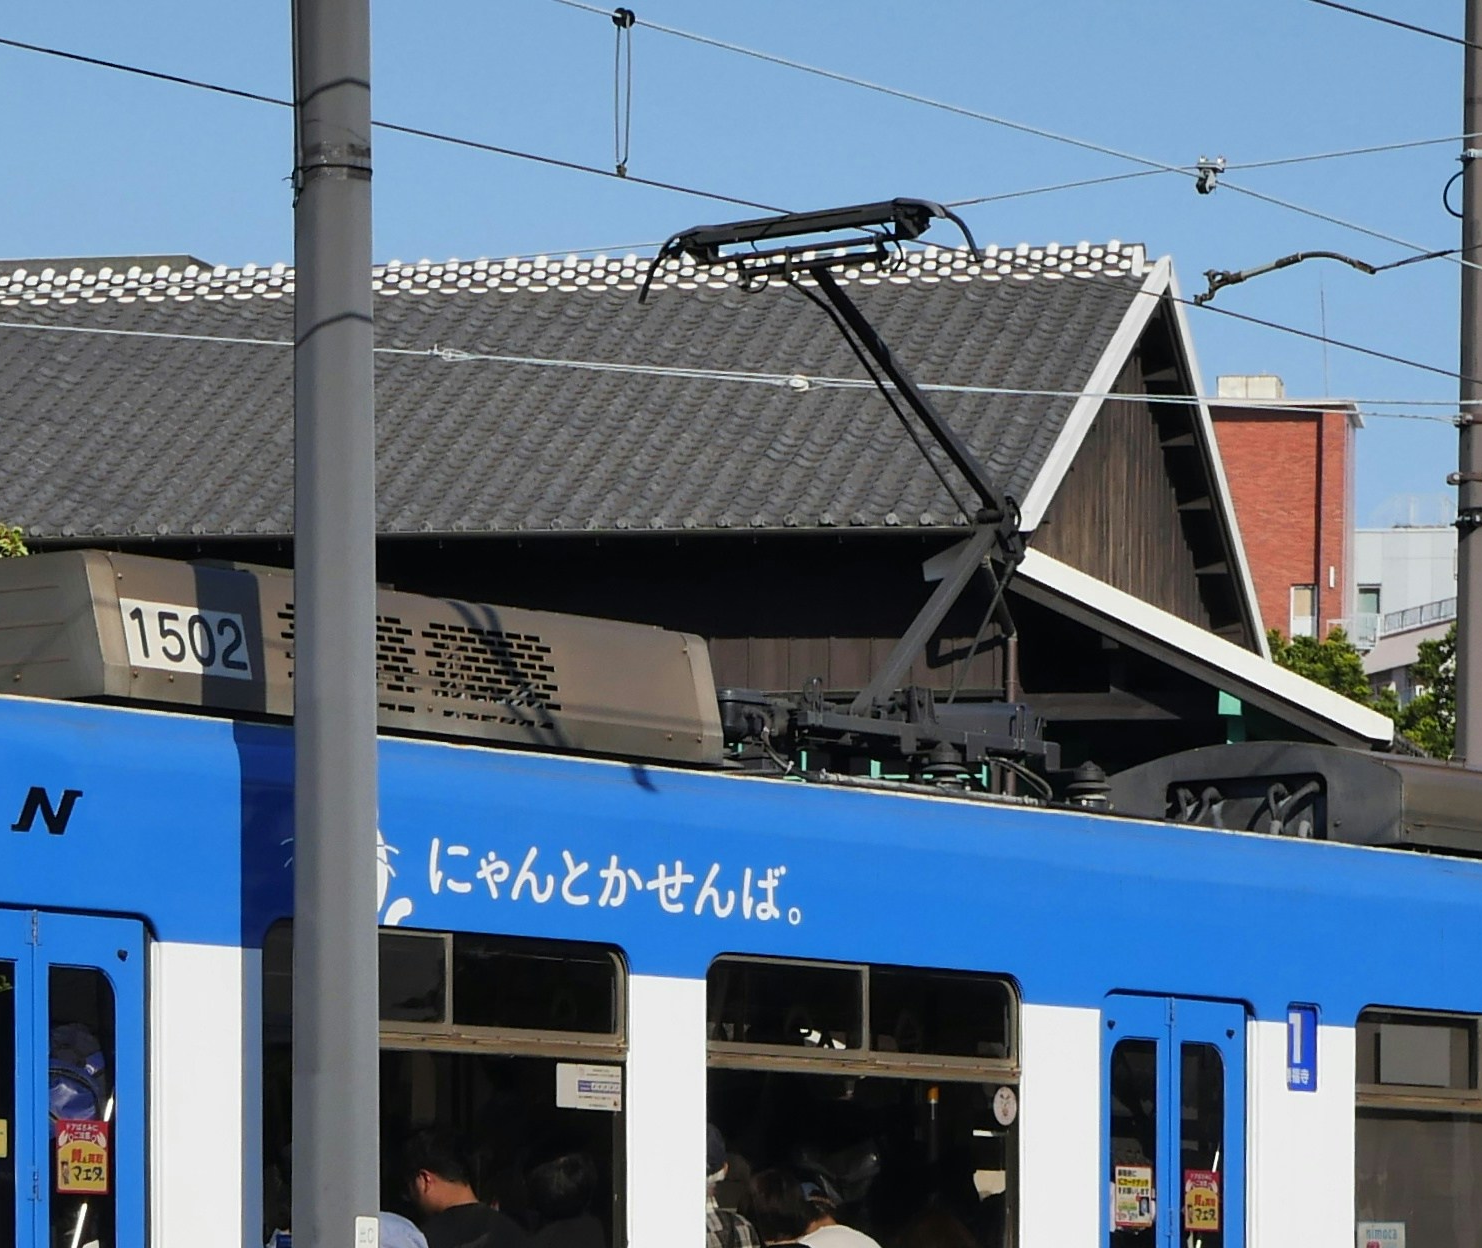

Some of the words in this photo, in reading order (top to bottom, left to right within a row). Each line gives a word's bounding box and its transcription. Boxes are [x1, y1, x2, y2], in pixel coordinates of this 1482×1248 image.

[129, 606, 249, 671] 1502
[429, 836, 802, 926] にゃんとかせんば。
